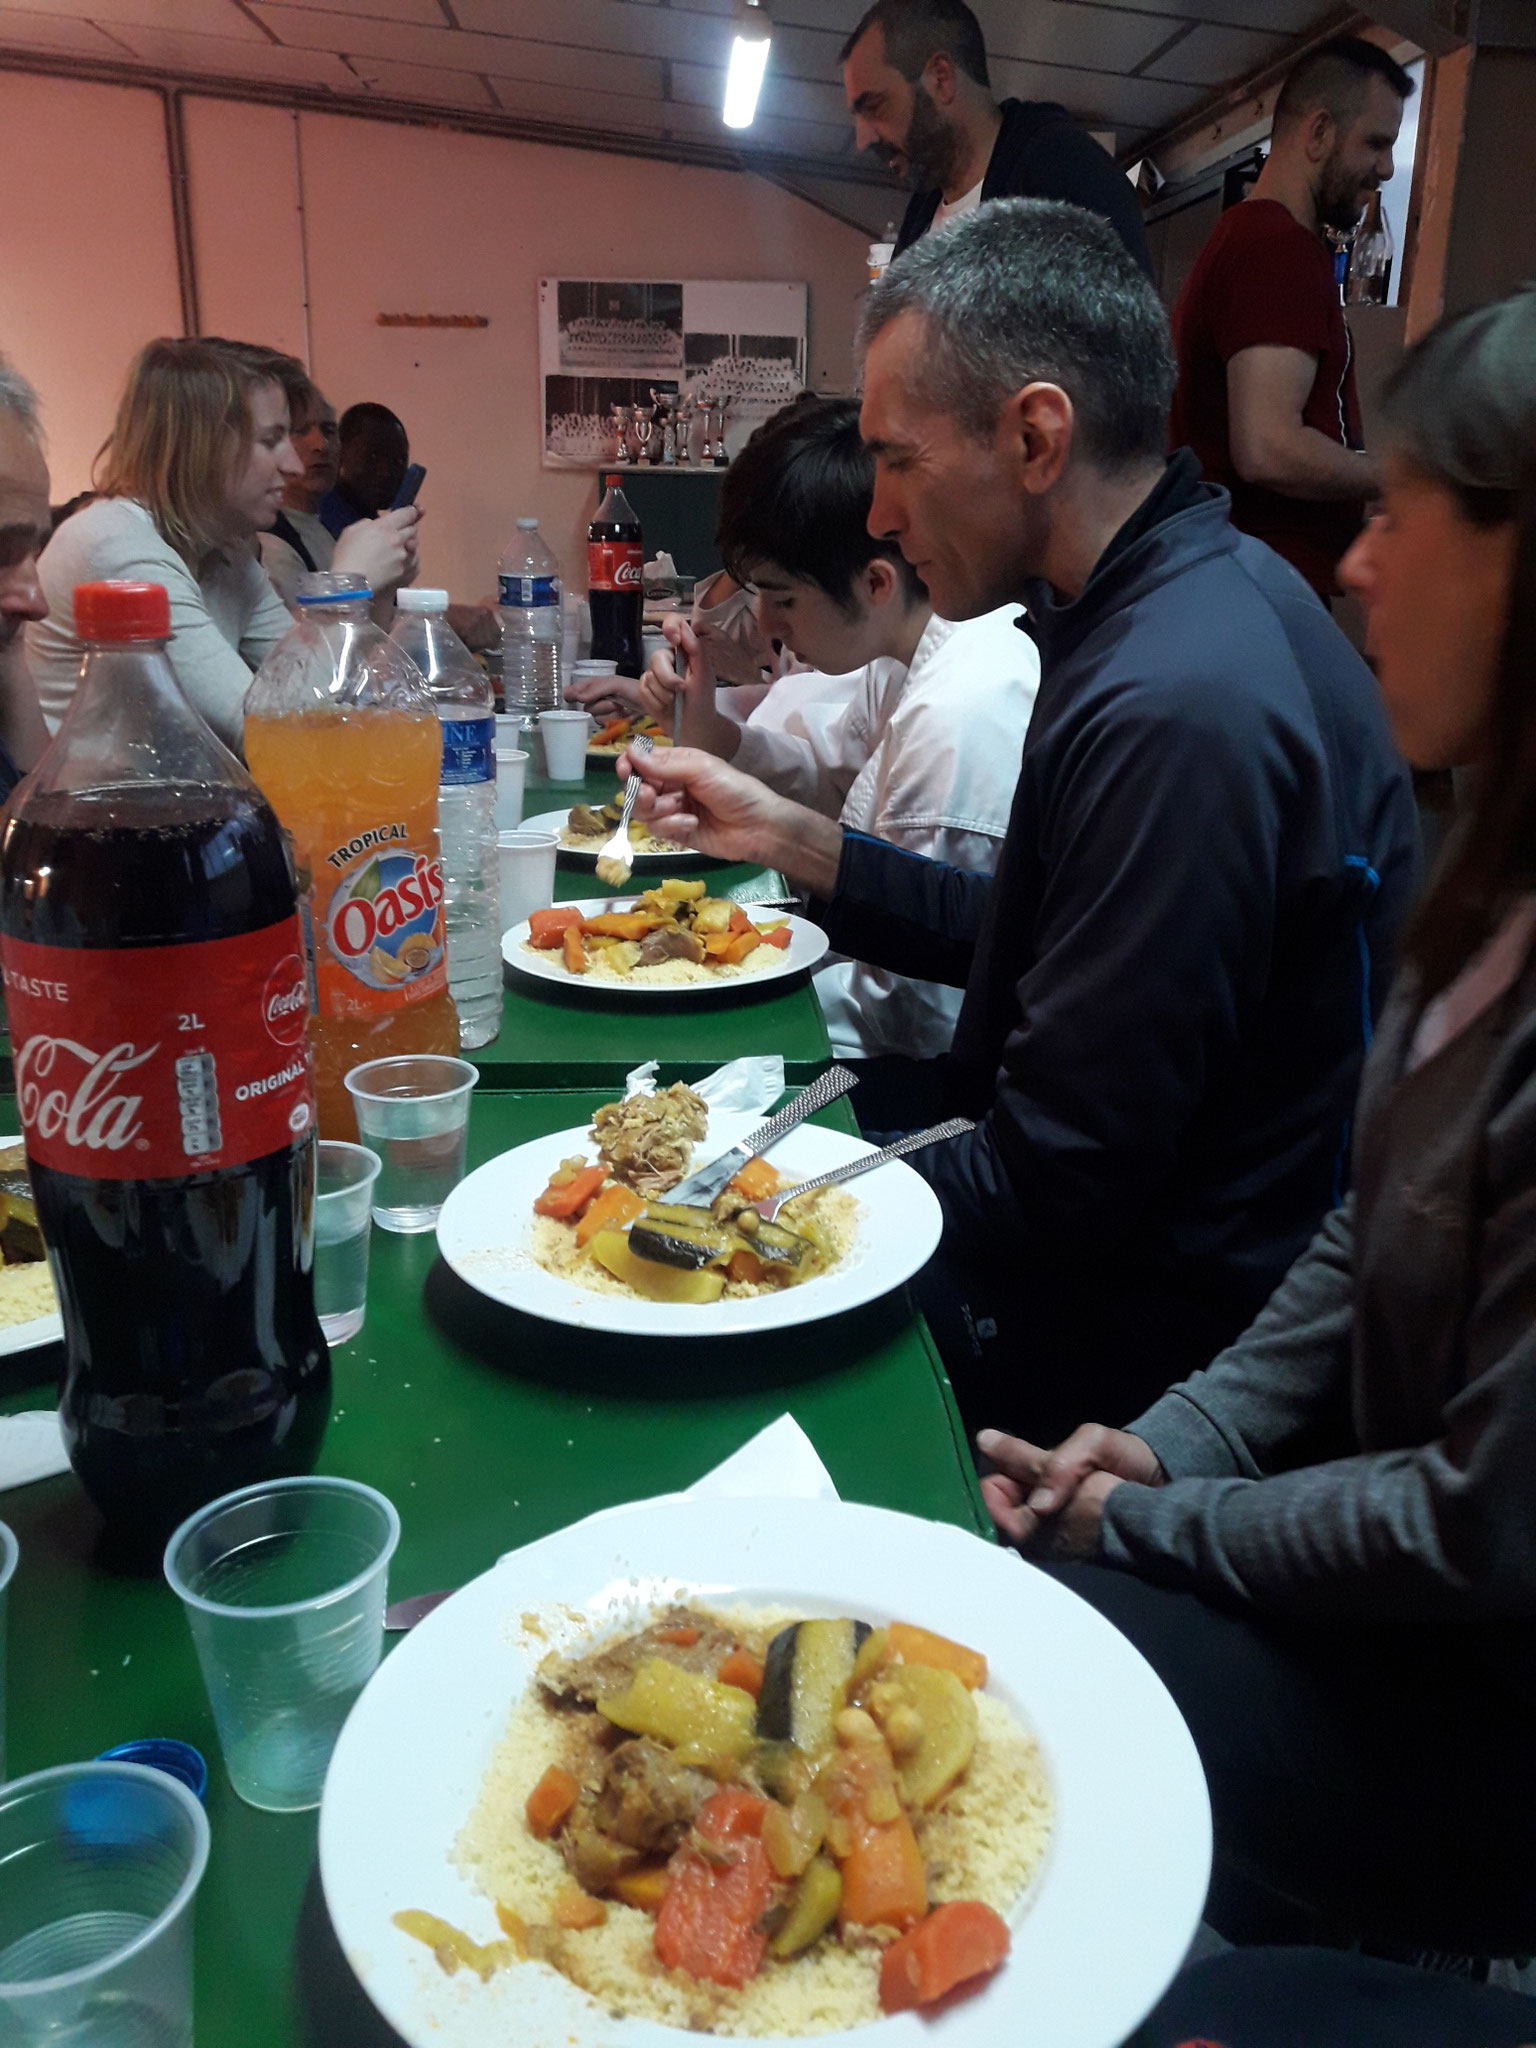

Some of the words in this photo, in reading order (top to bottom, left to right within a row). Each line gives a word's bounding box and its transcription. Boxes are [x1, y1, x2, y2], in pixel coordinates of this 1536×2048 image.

[327, 823, 409, 870] TROPICAL
[332, 855, 444, 957] Oasis
[10, 970, 70, 1002] TASTE
[177, 1013, 206, 1032] 2L
[234, 1060, 306, 1102] ORIGINAL
